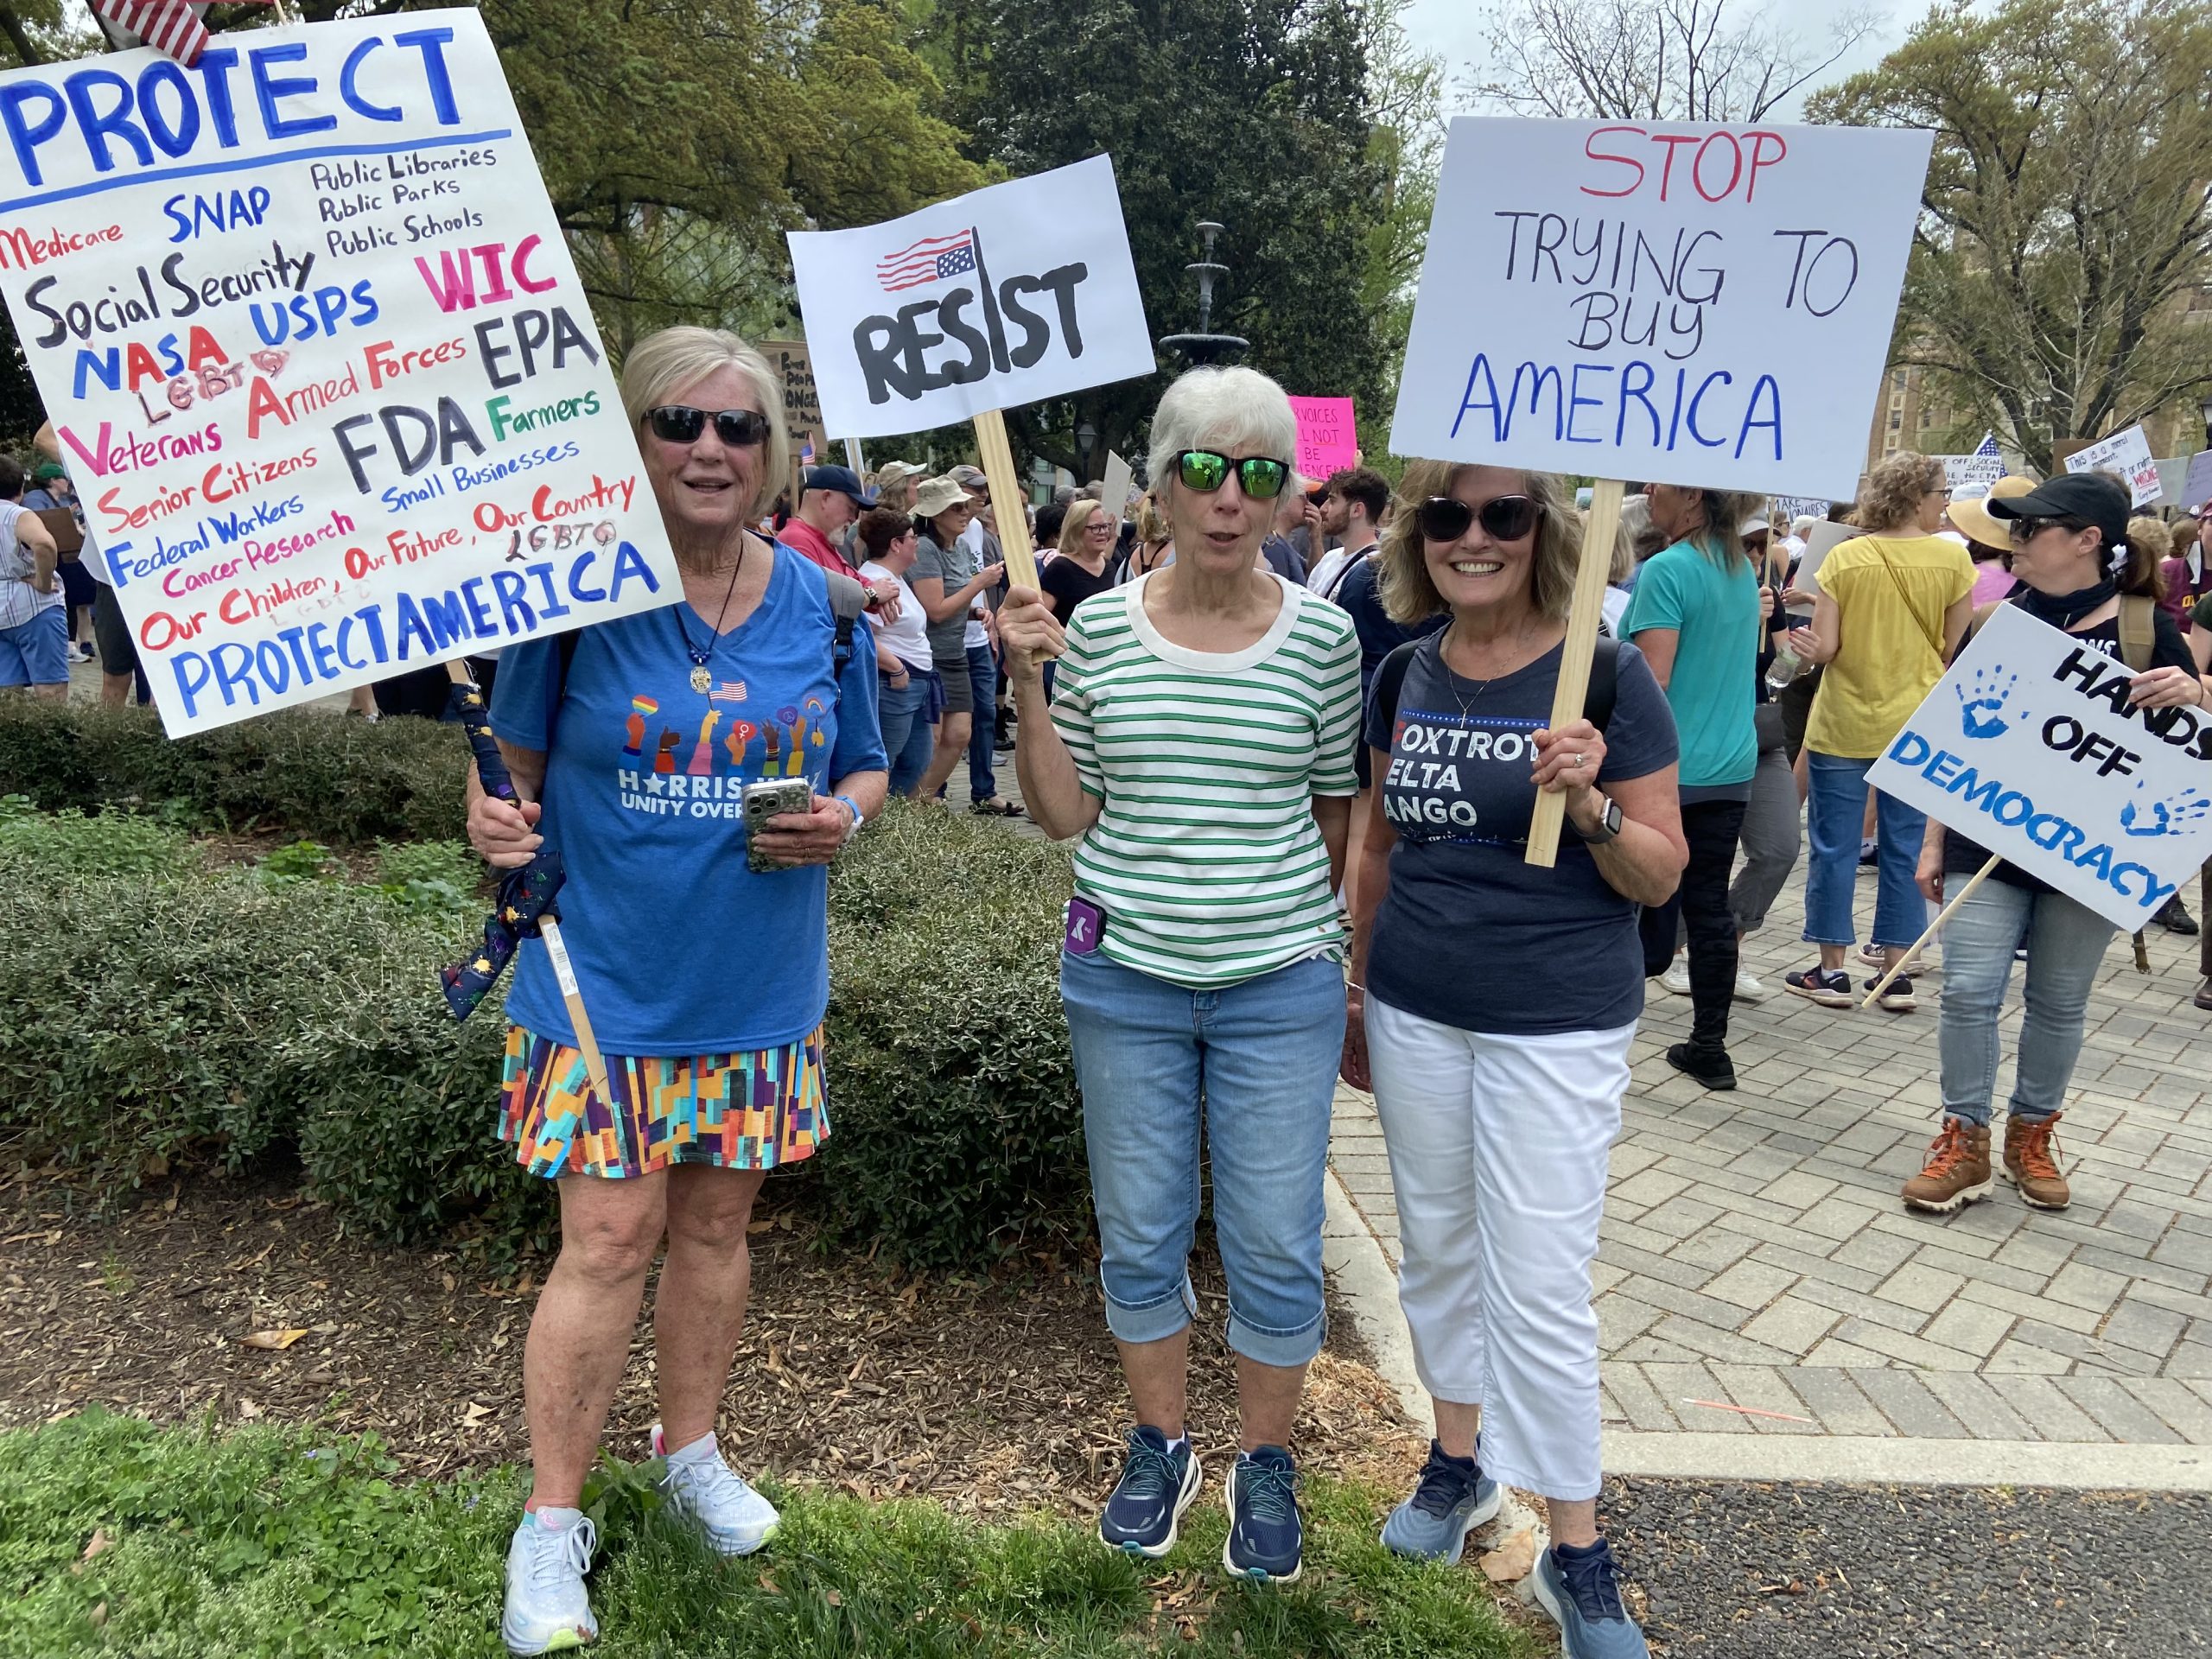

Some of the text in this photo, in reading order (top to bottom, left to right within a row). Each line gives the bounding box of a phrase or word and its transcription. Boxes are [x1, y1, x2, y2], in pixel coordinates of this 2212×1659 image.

[0, 27, 461, 187] PROTECT
[310, 149, 497, 191] Public Libraries
[1580, 126, 1786, 203] STOP
[163, 186, 270, 243] SNAP
[318, 193, 383, 223] Public
[327, 207, 483, 257] Public Schools
[0, 224, 124, 270] Medicare
[414, 234, 557, 313] WIC
[1495, 212, 1859, 317] TRYING TO
[24, 240, 315, 349] Social Security
[249, 278, 379, 346] USPS
[853, 226, 1088, 404] RESIST
[1567, 291, 1703, 359] BUY
[73, 325, 229, 399] NASA
[474, 305, 600, 390] EPA
[248, 337, 467, 440] Armed Forces
[485, 390, 601, 442] Farmers
[1301, 408, 1338, 423] VOICES
[1451, 353, 1783, 461] AMERICA
[58, 422, 222, 477] Veterans
[332, 396, 486, 495] FDA
[1305, 447, 1321, 460] BE
[1313, 429, 1339, 443] NOT
[2065, 454, 2087, 470] This
[97, 447, 318, 534] Senior Citizens
[381, 442, 580, 513] Small Businesses
[105, 494, 304, 588] Federal Workers
[140, 610, 207, 651] Our
[344, 547, 387, 580] Our
[473, 502, 527, 532] Our
[531, 474, 636, 522] Country
[162, 510, 355, 598] Cancer Research
[1385, 758, 1461, 791] ELTA
[2042, 715, 2142, 778] OFF
[621, 792, 685, 816] UNITY
[1383, 793, 1478, 827] ANGO
[1888, 730, 2177, 907] DEMOCRACY
